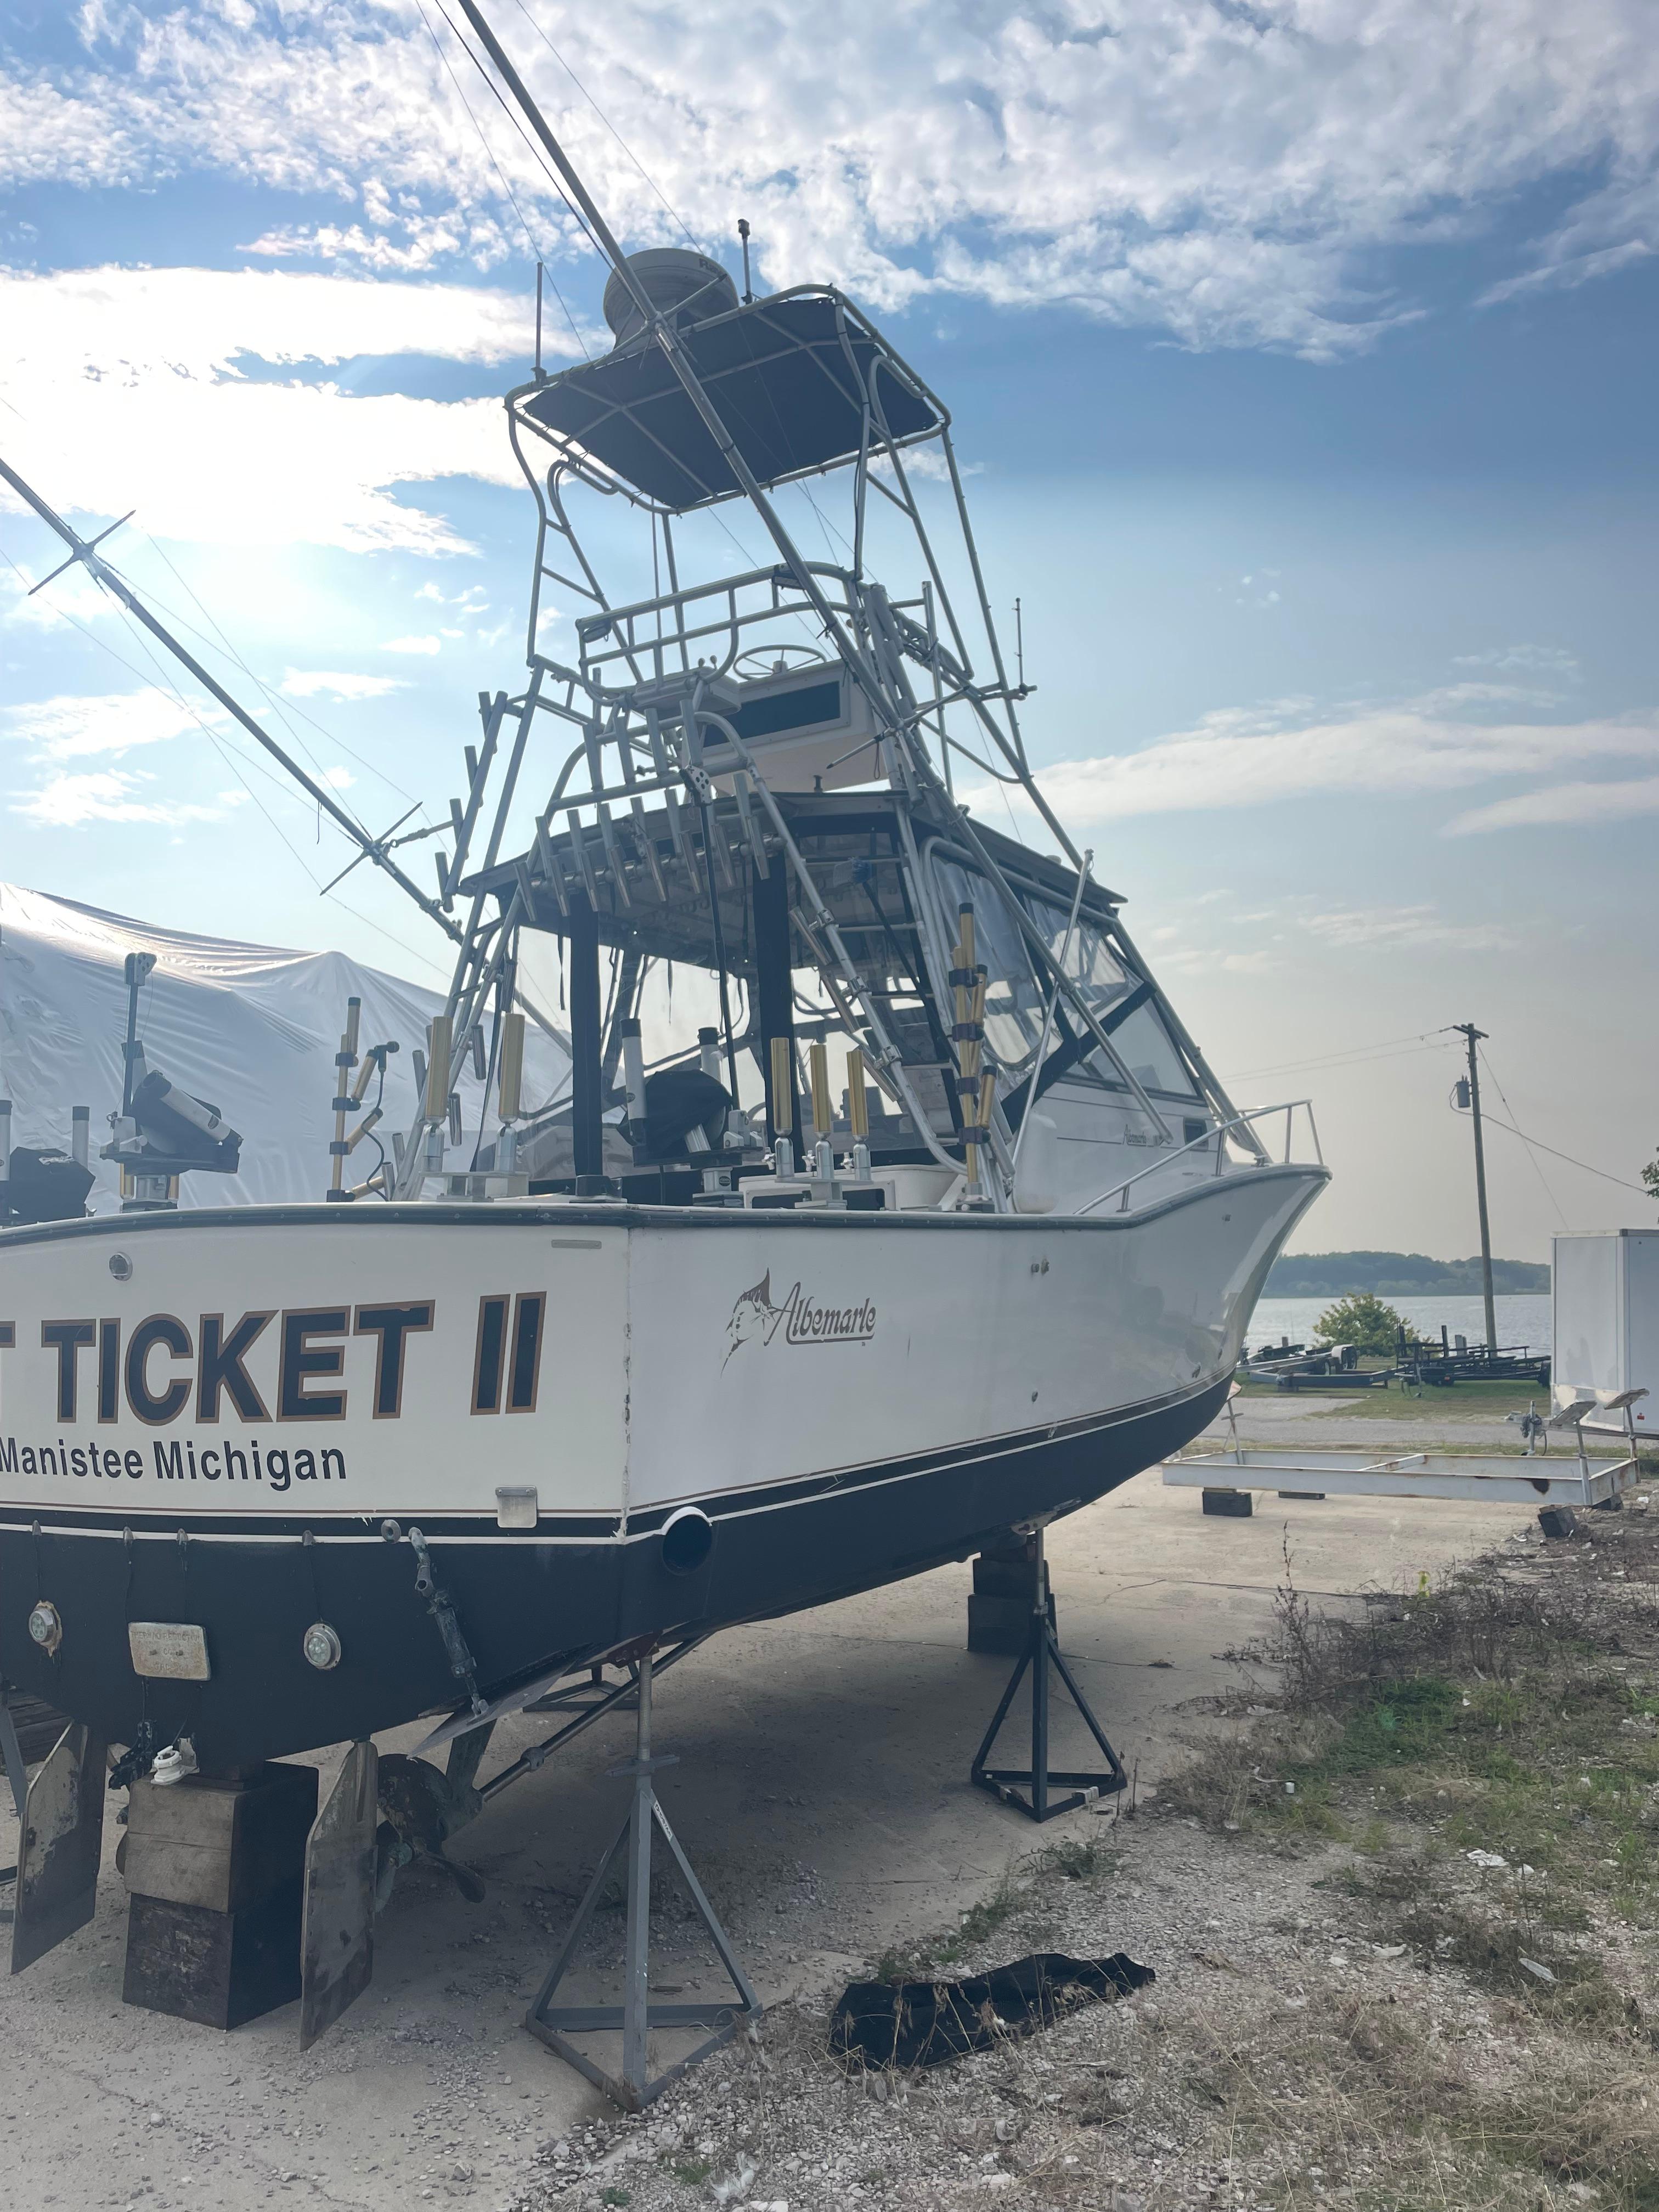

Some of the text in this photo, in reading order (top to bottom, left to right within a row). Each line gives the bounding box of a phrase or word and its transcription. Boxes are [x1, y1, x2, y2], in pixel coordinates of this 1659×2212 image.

[764, 1281, 876, 1345] Albemarle
[41, 1291, 547, 1426] TICKET II
[0, 1437, 347, 1492] Manistee Michigan
